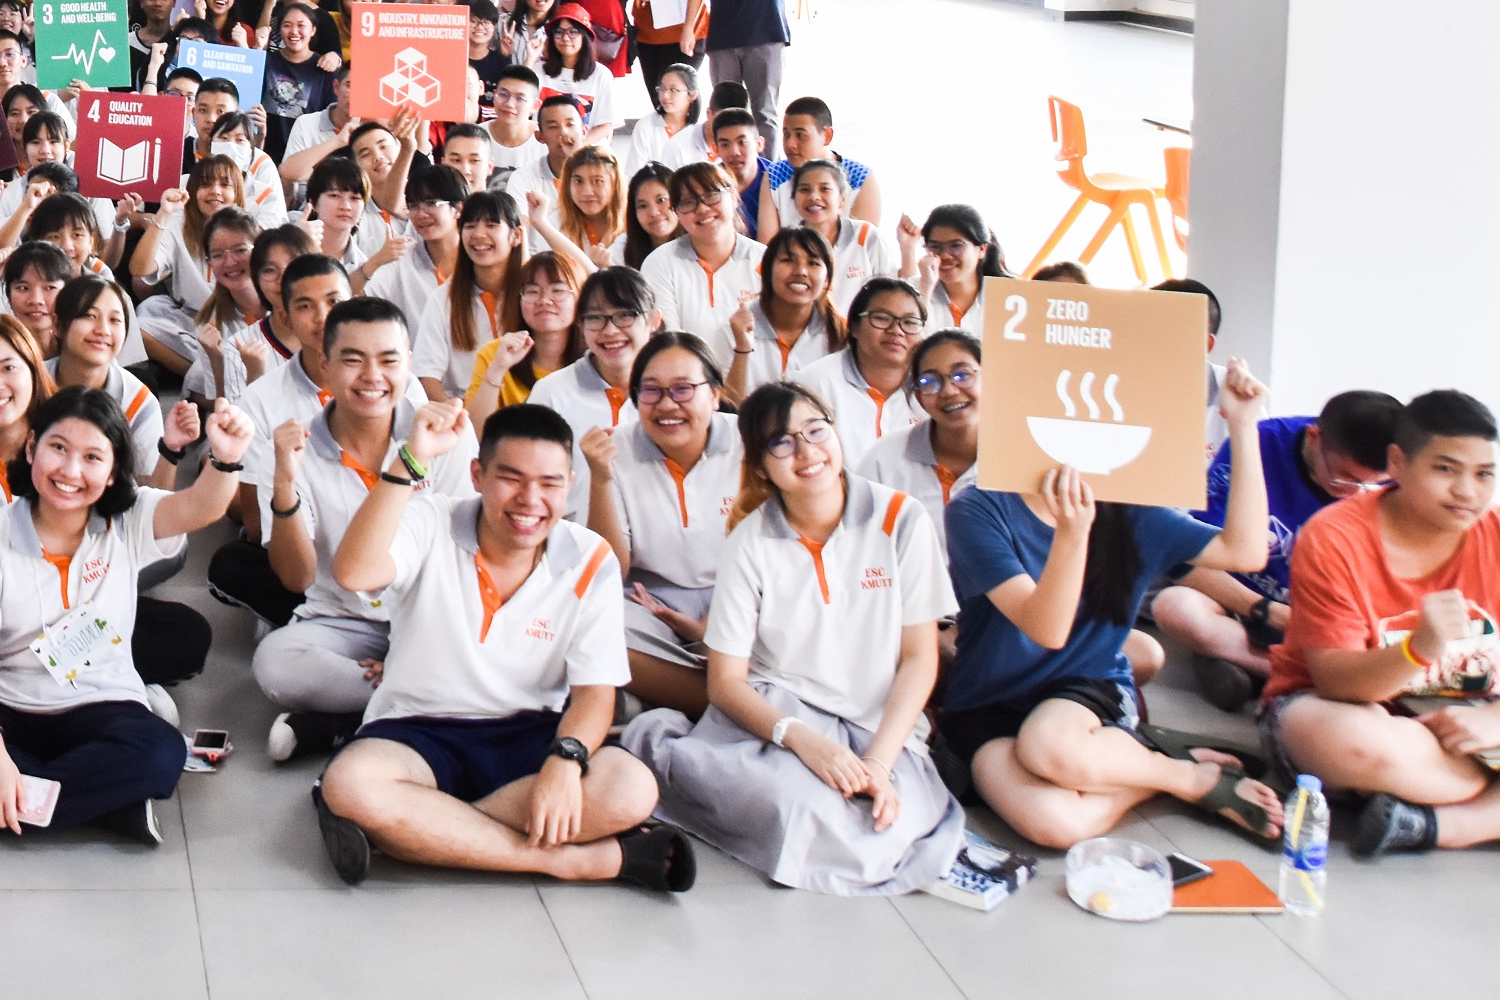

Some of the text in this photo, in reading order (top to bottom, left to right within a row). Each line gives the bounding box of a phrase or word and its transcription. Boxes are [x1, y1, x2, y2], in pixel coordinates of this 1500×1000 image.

[42, 3, 53, 25] 3
[60, 2, 107, 13] GOOD HEALTH
[61, 12, 116, 24] AND WELL-BEING
[361, 11, 375, 37] 9
[420, 13, 466, 26] INNOVATION
[378, 26, 464, 40] AND INFRASTRUCTURE
[186, 47, 197, 66] 6
[203, 50, 247, 63] CLEAN WATER
[202, 59, 253, 74] AND SANITATION
[87, 100, 100, 122] 4
[109, 100, 143, 113] QUALITY
[108, 113, 152, 127] EDUCATION
[1045, 298, 1089, 322] ZERO
[1003, 294, 1028, 341] 2
[1045, 323, 1112, 349] HUNGER
[864, 567, 886, 578] ESC
[861, 577, 894, 590] KMUTT
